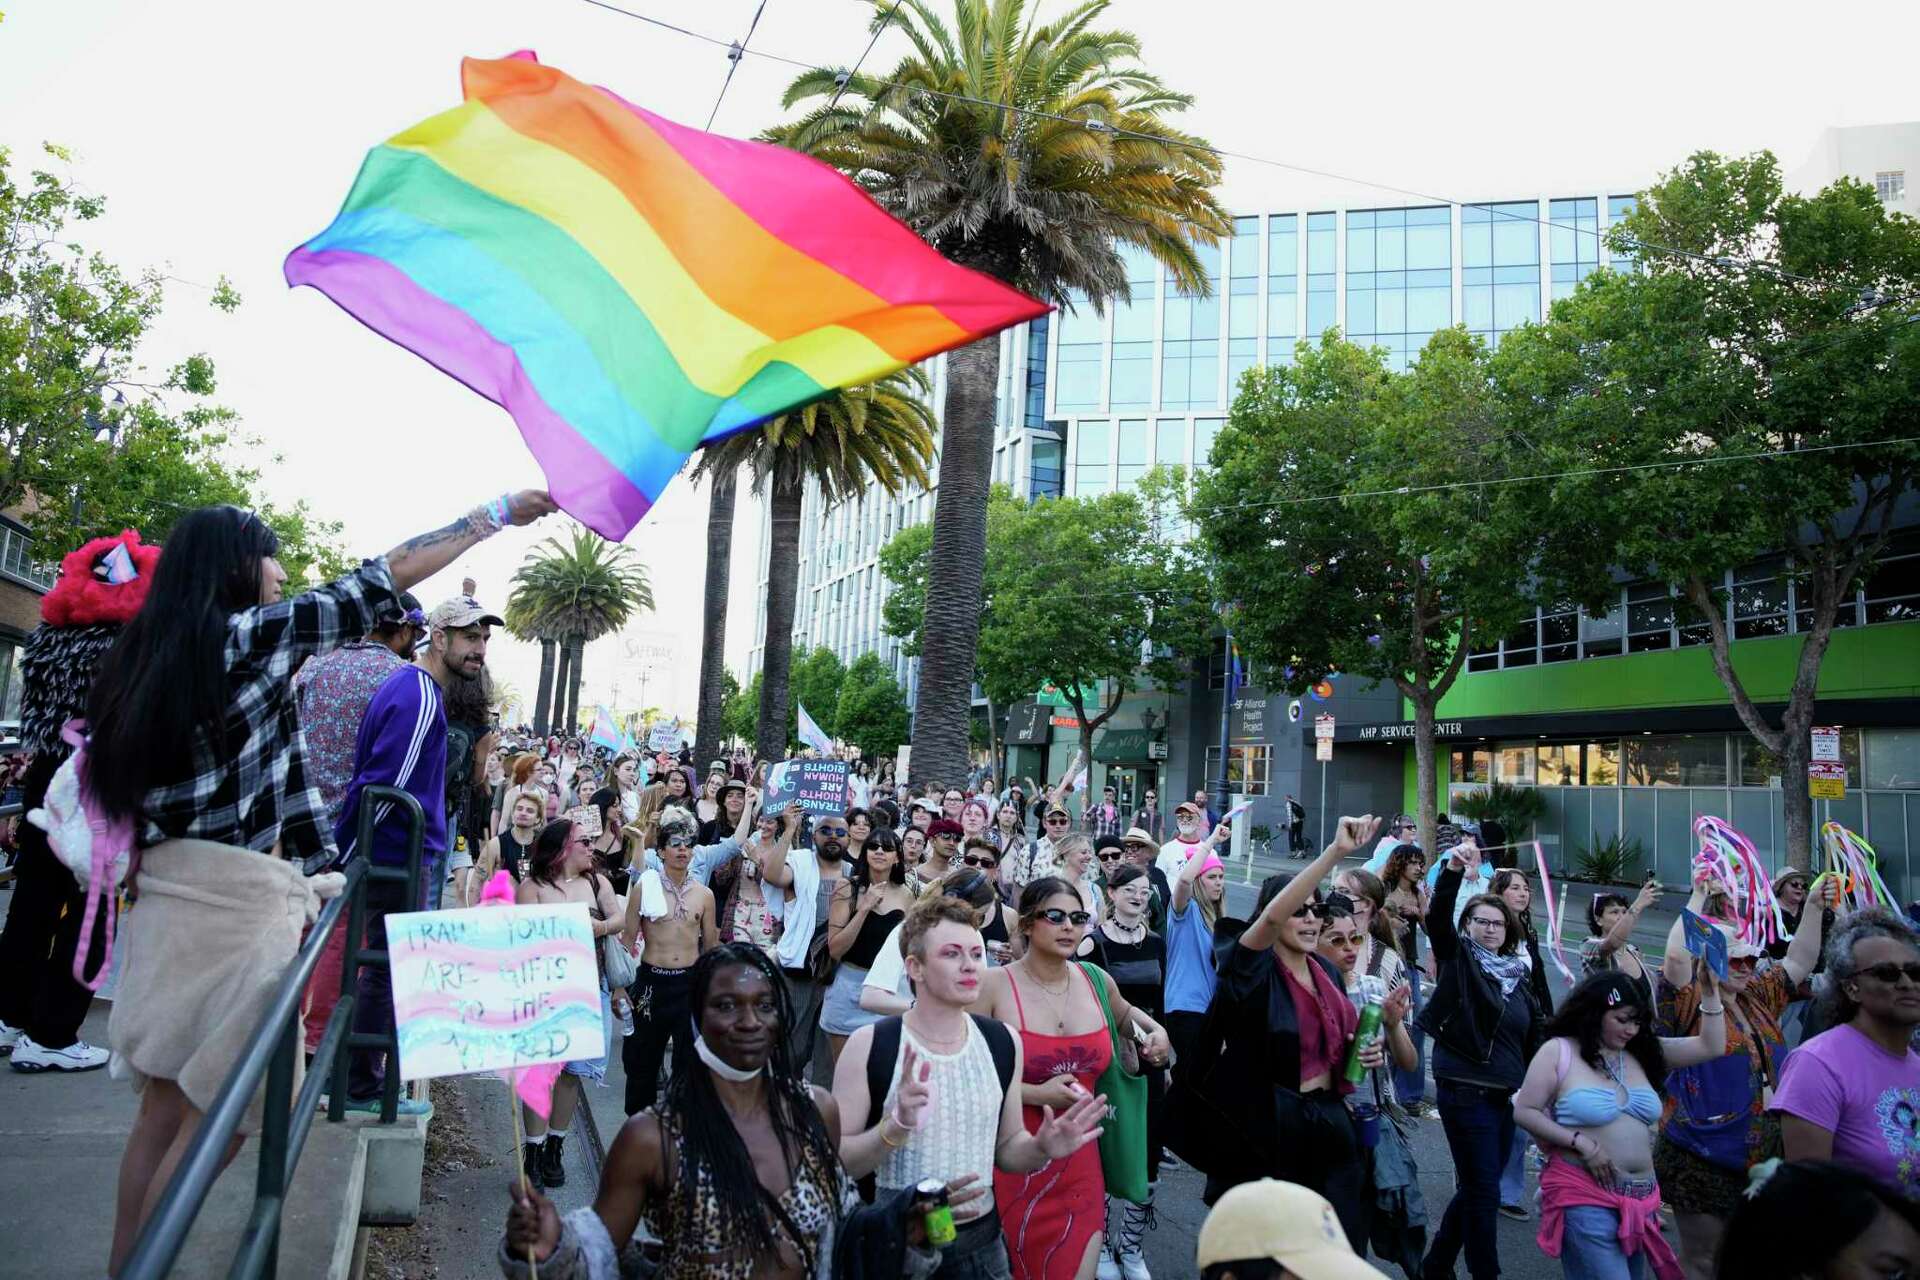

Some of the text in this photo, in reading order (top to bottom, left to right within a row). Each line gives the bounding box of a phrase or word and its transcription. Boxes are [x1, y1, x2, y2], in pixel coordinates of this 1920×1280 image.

[1243, 711, 1262, 720] Health
[1243, 722, 1263, 733] Project
[1359, 727, 1377, 739] AHP
[1434, 722, 1463, 735] ENTER
[804, 763, 846, 774] RIGHTS
[804, 771, 845, 783] HUMAN
[820, 782, 844, 792] ARE
[799, 789, 842, 802] RIGHTS
[766, 798, 841, 815] TRANSGNDER
[421, 960, 478, 993] ARE
[511, 992, 556, 1022] THE
